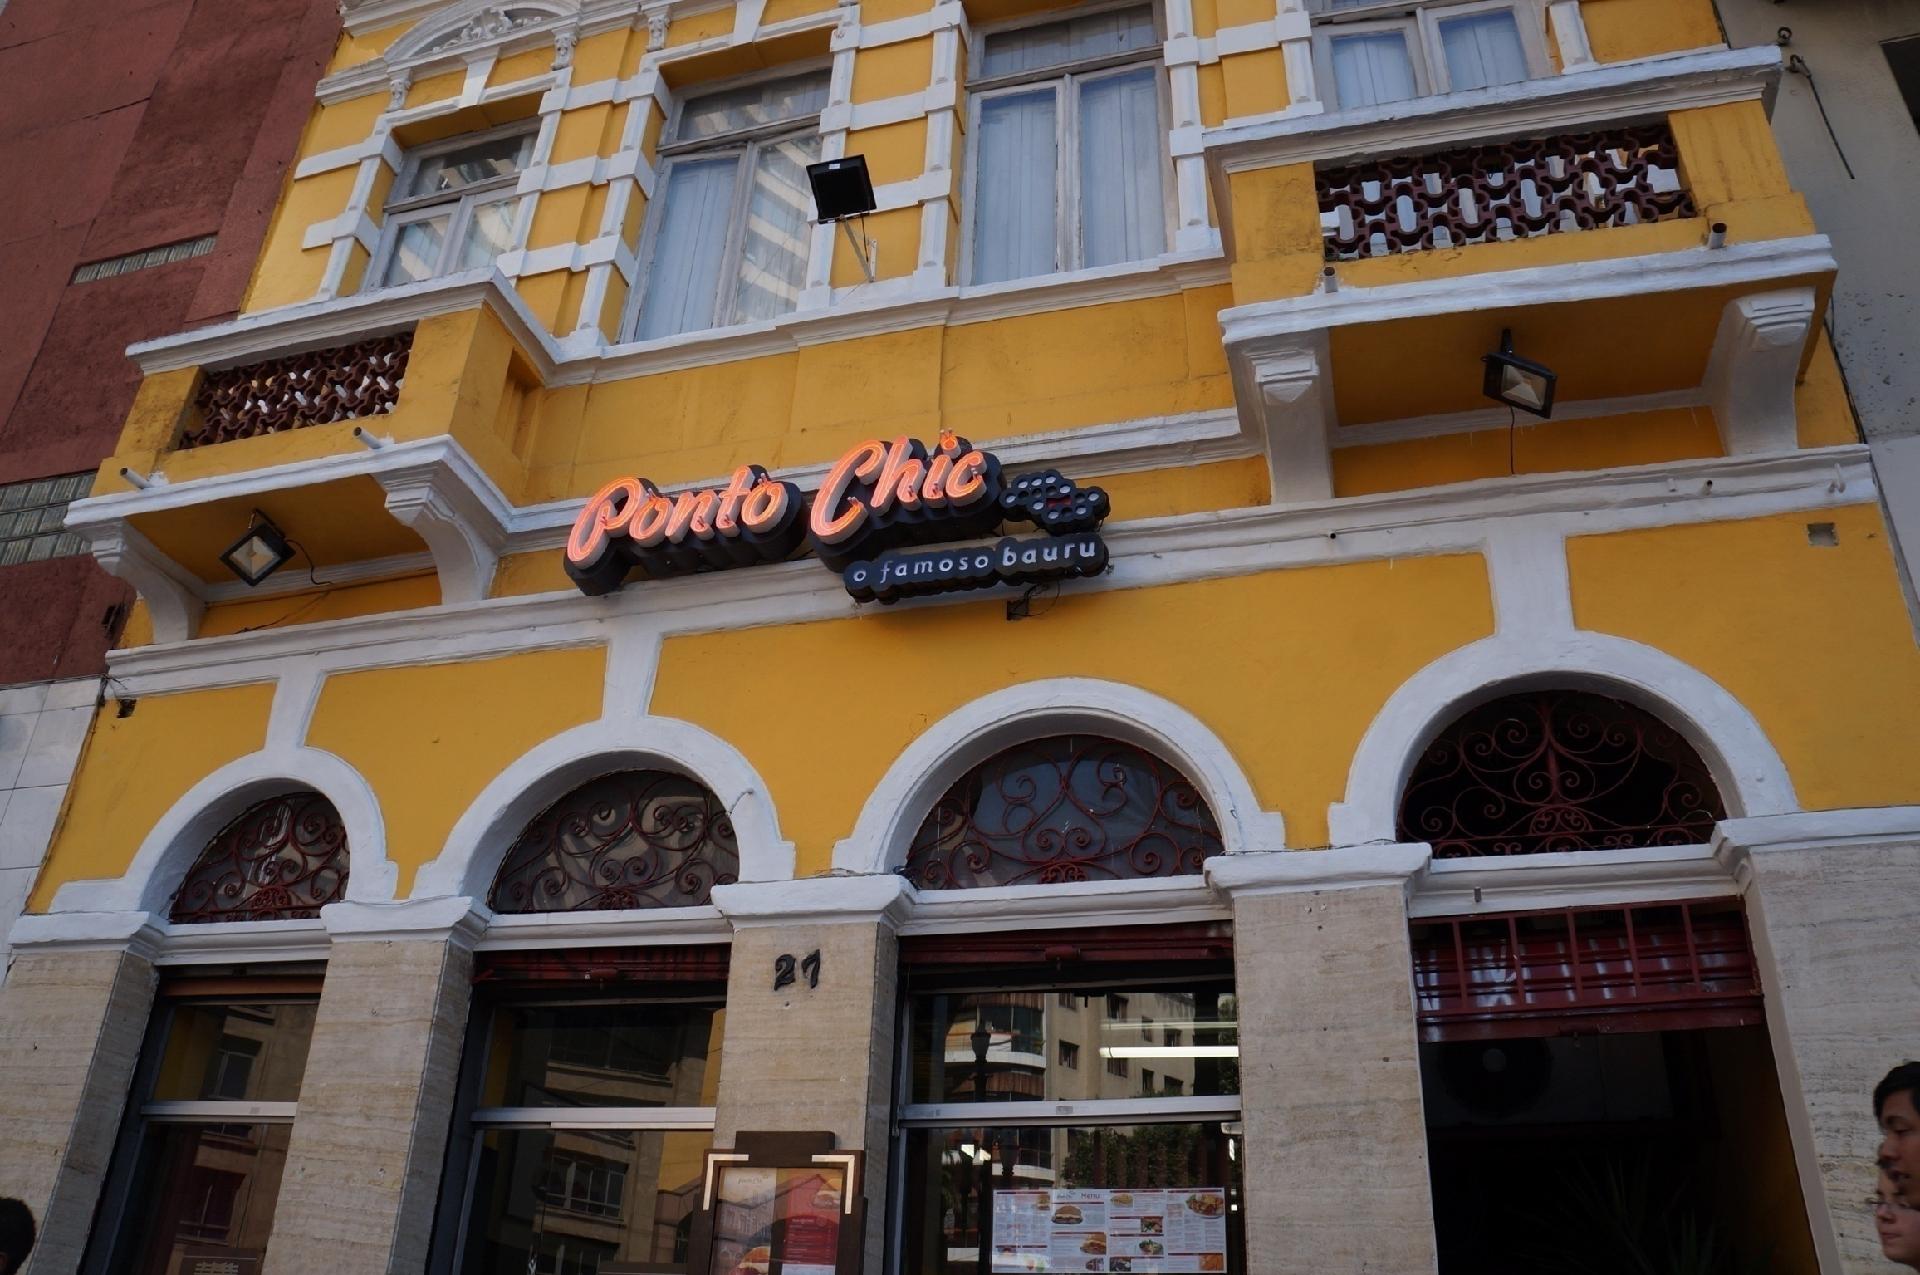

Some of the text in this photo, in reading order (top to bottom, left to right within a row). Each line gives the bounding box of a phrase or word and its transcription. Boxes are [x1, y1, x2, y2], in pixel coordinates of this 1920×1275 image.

[567, 434, 986, 565] Ponto Chic
[853, 540, 1097, 584] o famoso bauru
